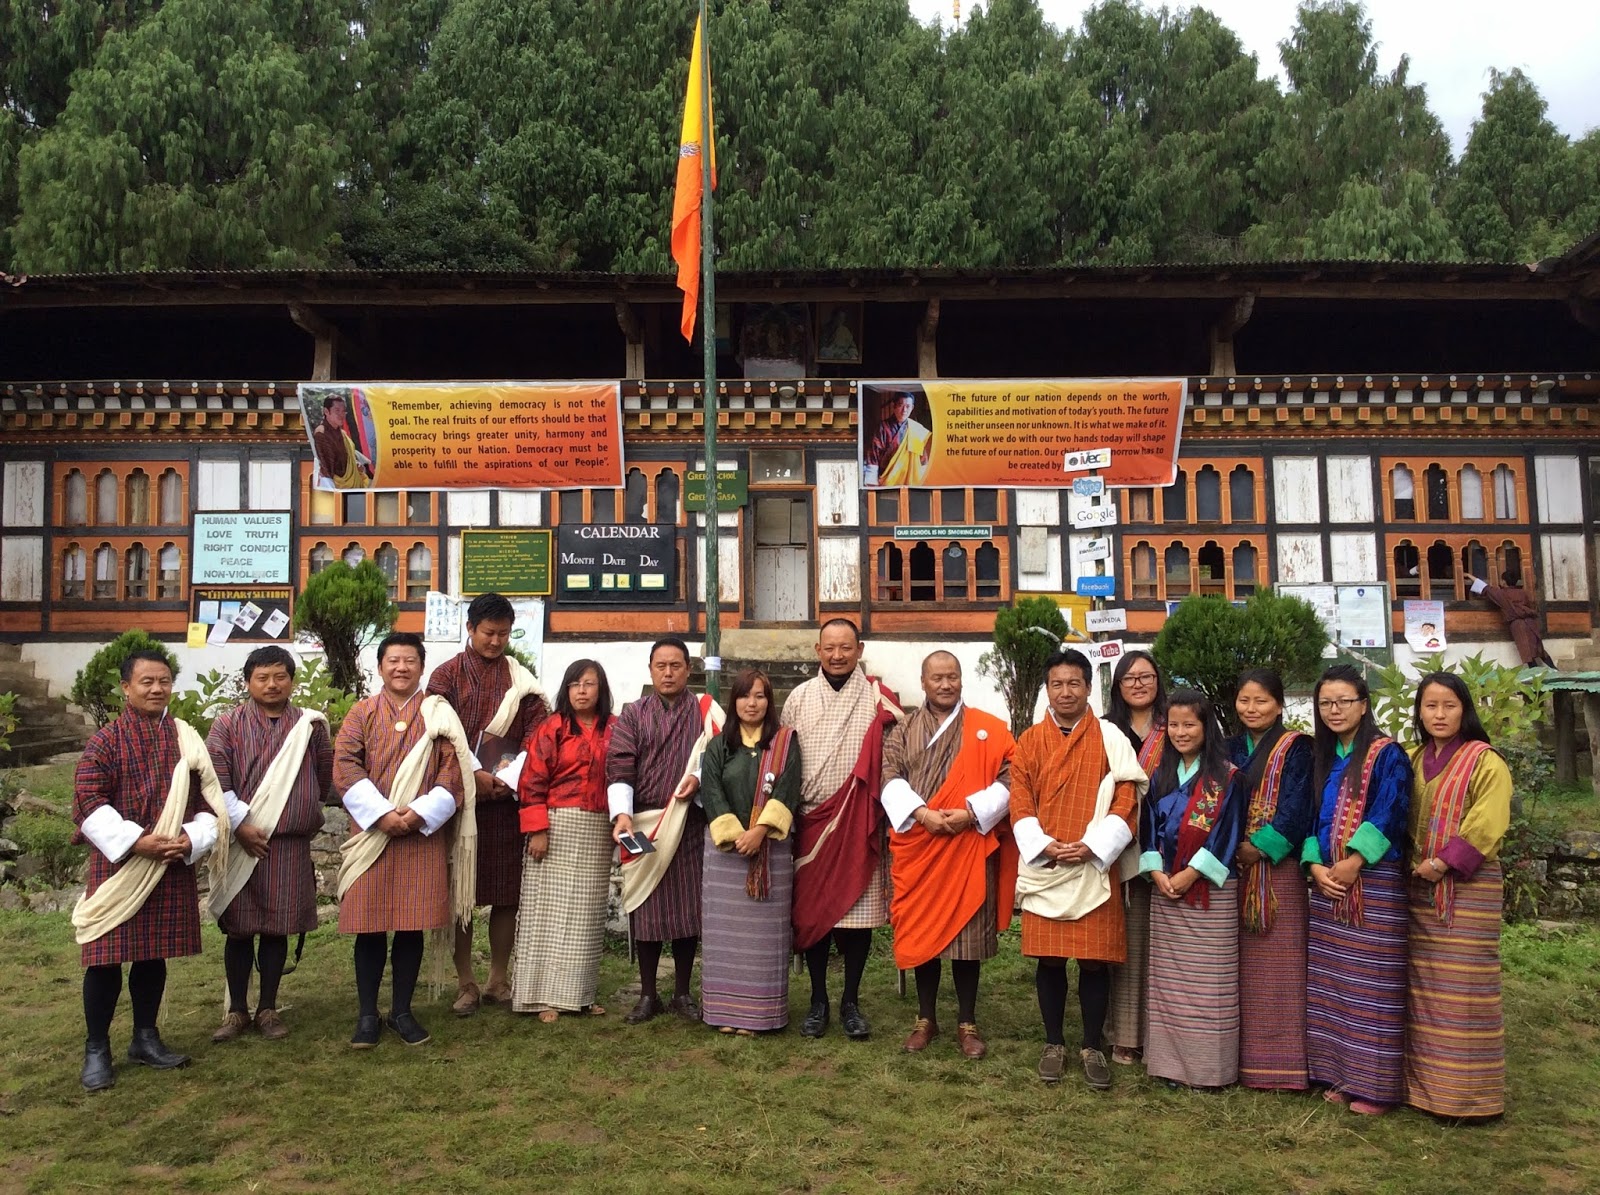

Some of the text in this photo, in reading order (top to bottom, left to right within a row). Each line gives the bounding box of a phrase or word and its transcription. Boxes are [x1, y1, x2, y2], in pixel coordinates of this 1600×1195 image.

[971, 393, 996, 402] future
[1002, 393, 1011, 402] of
[1016, 394, 1029, 402] our
[1035, 393, 1061, 402] nation
[1067, 392, 1102, 404] depends
[1124, 392, 1137, 401] the
[1143, 392, 1170, 403] worth,
[449, 400, 492, 412] achieving
[499, 399, 546, 412] democracy
[554, 399, 561, 409] is
[568, 400, 583, 409] not
[591, 398, 606, 408] the
[947, 406, 993, 418] capabilities
[995, 406, 1010, 416] and
[1012, 406, 1057, 416] motivation
[1059, 406, 1067, 415] of
[1099, 406, 1125, 418] youth.
[1127, 406, 1141, 415] The
[1143, 405, 1168, 415] future
[389, 413, 606, 427] goal. The real fruits of our efforts should be that
[947, 419, 1167, 429] is neither unseen nor unknown. It is what we make of it.
[390, 428, 607, 442] democracy brings greater unity, harmony and
[947, 433, 1166, 444] What work we do with our two hands today will shape
[392, 443, 608, 456] prosperity to our Nation. Democracy must be
[946, 447, 959, 456] the
[961, 447, 986, 456] future
[988, 447, 997, 456] of
[999, 448, 1012, 456] our
[1014, 447, 1041, 456] nation.
[1044, 447, 1059, 456] Our
[1141, 446, 1154, 455] has
[1156, 447, 1164, 455] to
[394, 460, 413, 469] able
[419, 461, 428, 469] to
[434, 459, 457, 469] fulfill
[464, 459, 478, 469] the
[484, 458, 533, 470] aspirations
[539, 458, 548, 467] of
[554, 459, 569, 467] our
[1008, 460, 1061, 472] be created by
[1075, 481, 1102, 494] skype
[1077, 509, 1114, 524] Google
[581, 526, 660, 539] CALENDAR
[204, 544, 287, 553] RIGHT CONDUCT
[221, 558, 253, 566] PEACE
[1081, 582, 1110, 590] facebook
[1091, 616, 1121, 624] WIKIPEDIA
